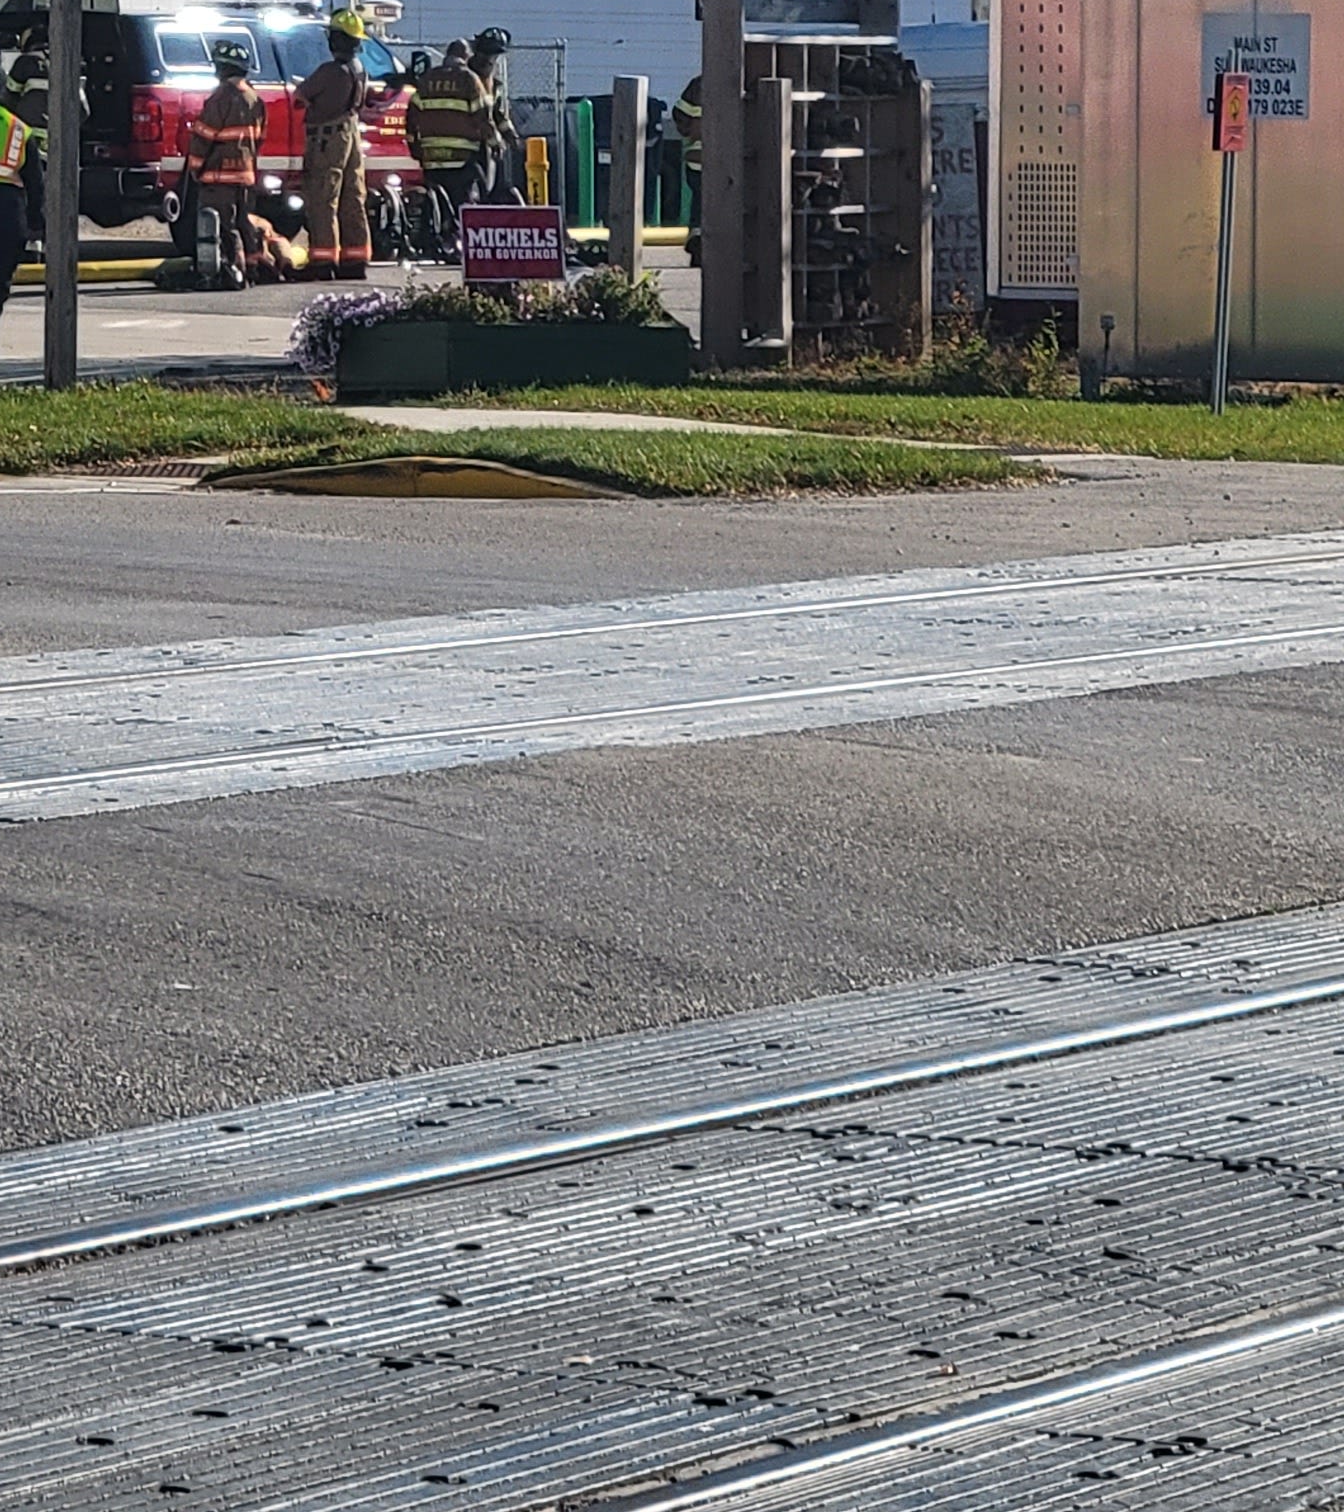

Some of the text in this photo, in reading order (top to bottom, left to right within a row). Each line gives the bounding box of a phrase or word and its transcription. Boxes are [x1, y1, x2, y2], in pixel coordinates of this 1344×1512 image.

[1234, 36, 1279, 53] MAIN ST
[1240, 57, 1297, 74] WAUKESHA
[1272, 99, 1304, 116] 023E
[467, 227, 558, 248] MICHELS
[468, 248, 559, 260] FOR GOVERNOR
